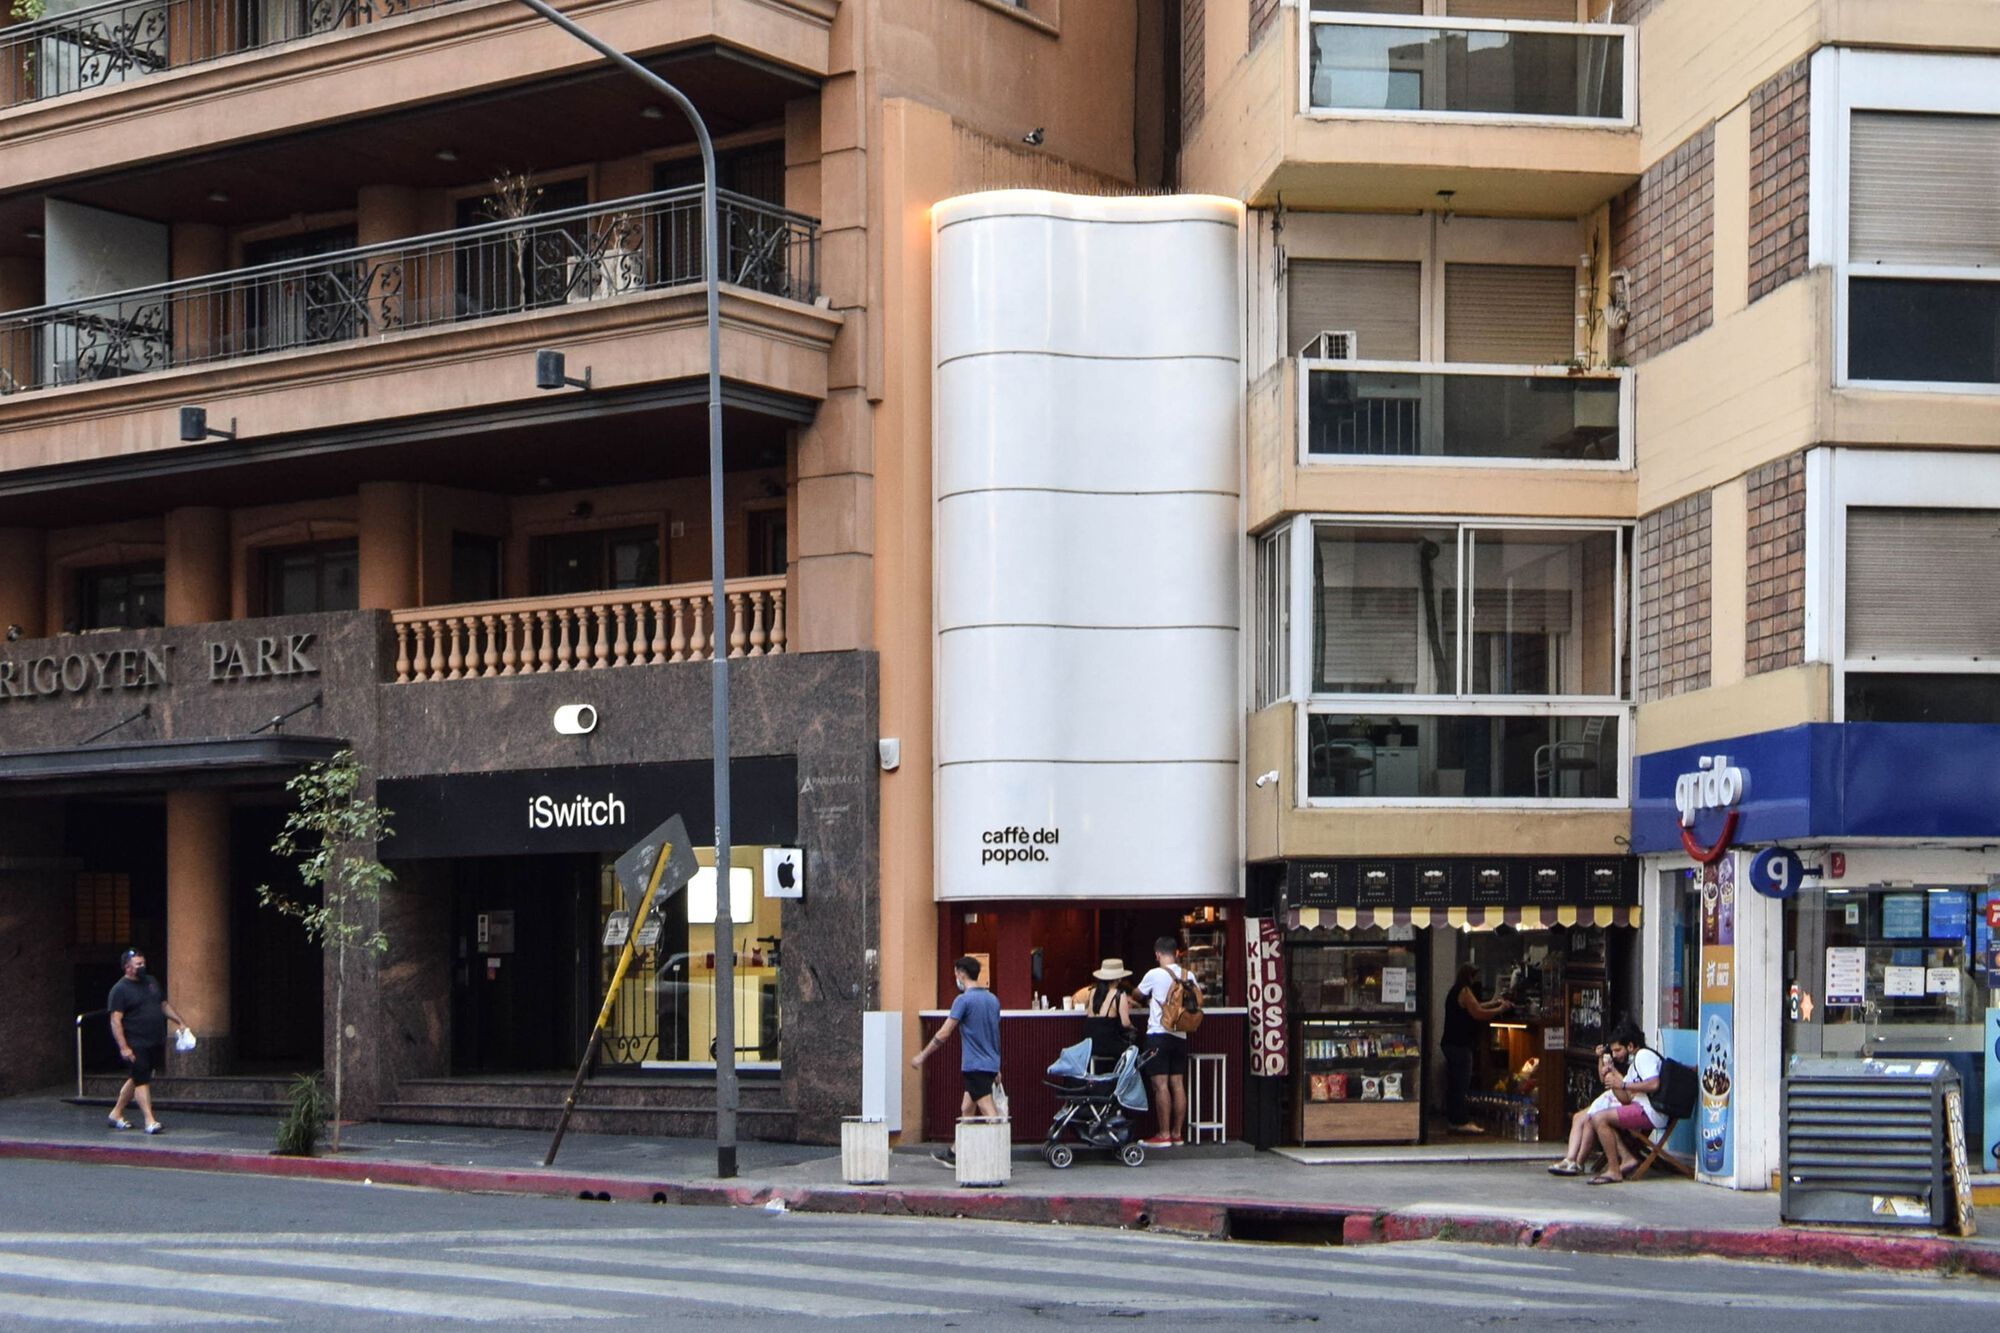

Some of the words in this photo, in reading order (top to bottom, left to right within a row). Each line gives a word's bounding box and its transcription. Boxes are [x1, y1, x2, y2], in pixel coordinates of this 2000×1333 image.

[208, 633, 320, 681] PARK
[528, 793, 626, 829] iSwitch
[1675, 755, 1742, 827] grido
[982, 827, 1030, 845] caffè
[1033, 828, 1059, 845] del
[982, 845, 1049, 866] popolo.
[1247, 941, 1262, 1073] KIOSCO
[1262, 941, 1285, 1075] KIOSCO
